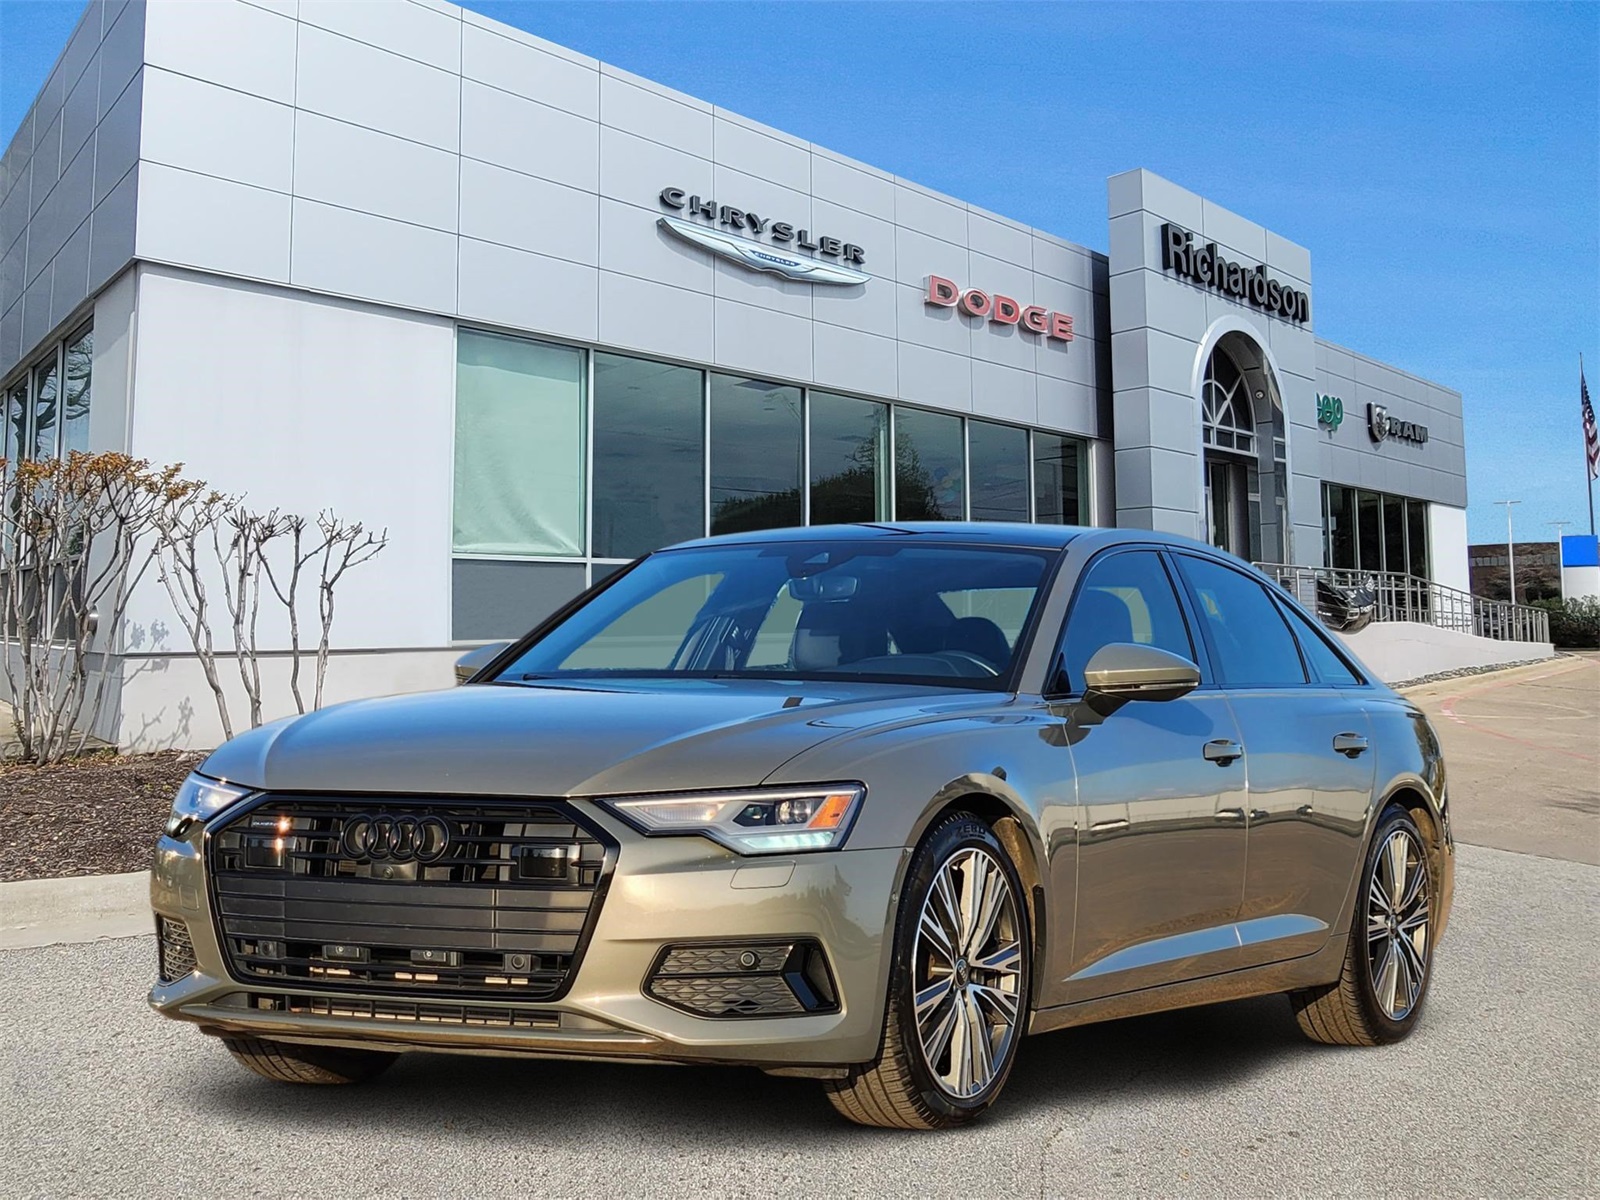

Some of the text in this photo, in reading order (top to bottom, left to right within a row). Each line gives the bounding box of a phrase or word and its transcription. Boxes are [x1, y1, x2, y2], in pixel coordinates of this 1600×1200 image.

[659, 186, 866, 264] CHRYSLER
[923, 275, 1074, 342] DODGE
[1161, 223, 1309, 323] Richardson
[1387, 416, 1428, 443] RAM
